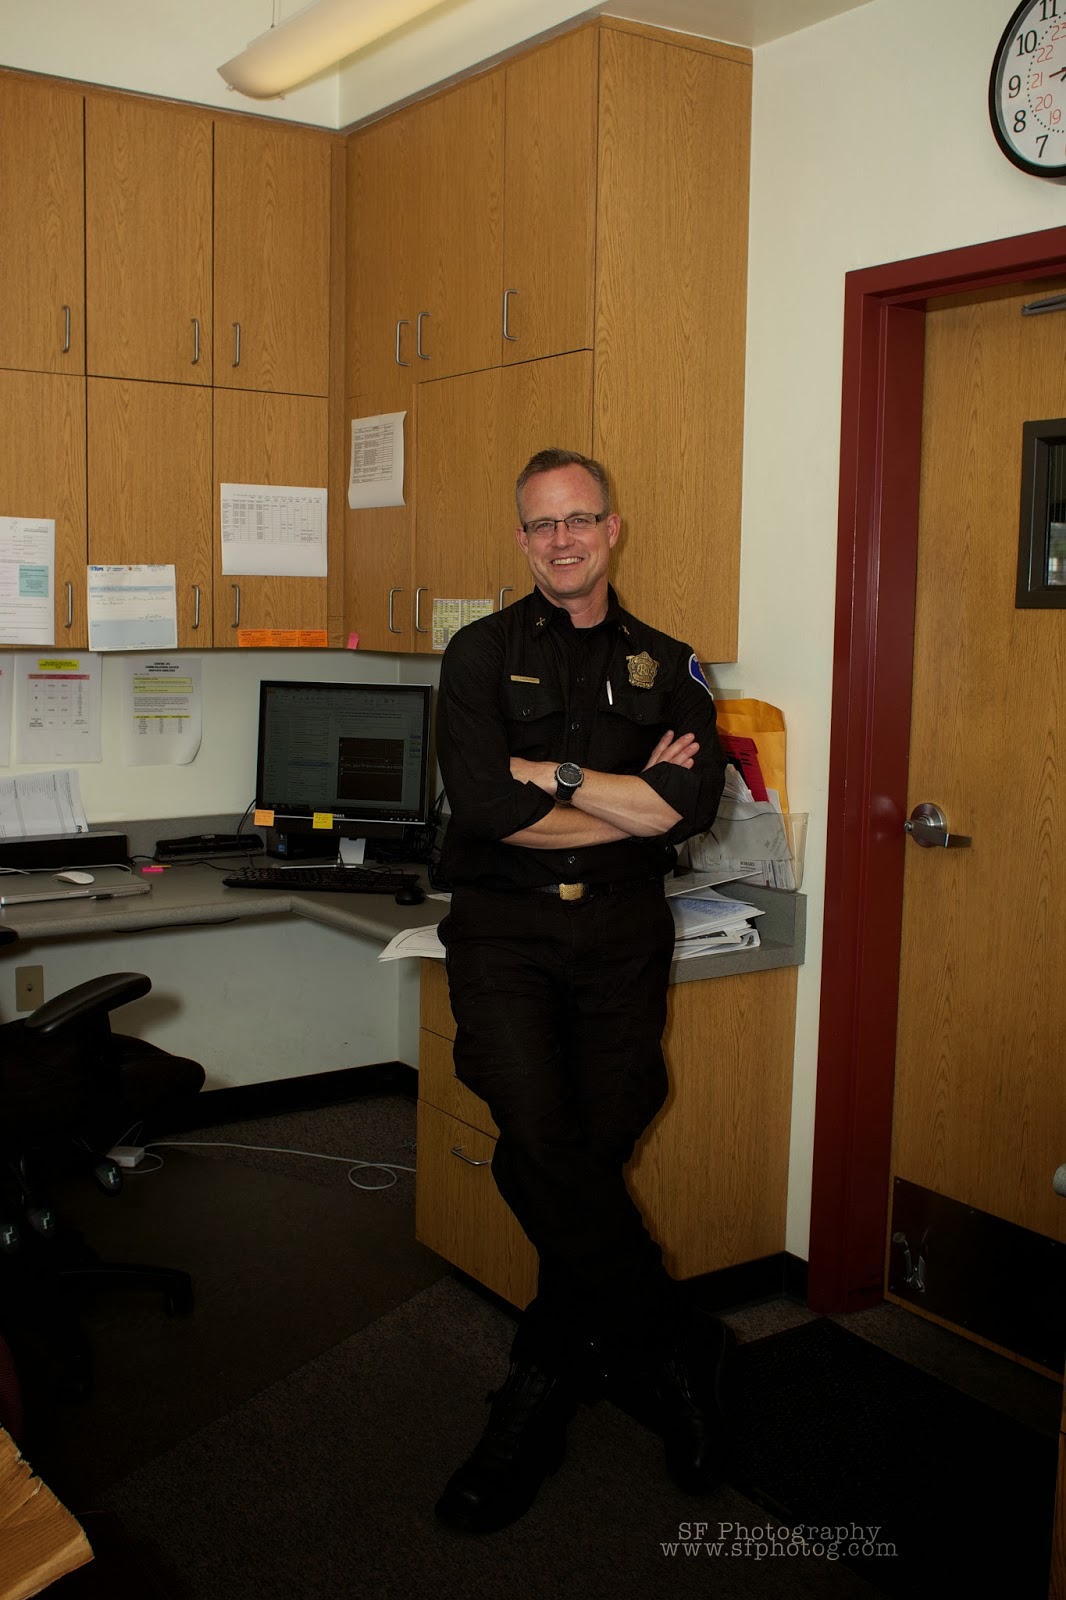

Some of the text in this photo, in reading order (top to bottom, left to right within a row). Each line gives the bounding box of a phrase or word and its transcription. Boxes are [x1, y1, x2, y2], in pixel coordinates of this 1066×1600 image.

[1039, 0, 1058, 22] 11
[1016, 30, 1038, 57] 10
[1036, 45, 1054, 63] 22
[1008, 75, 1021, 99] 9
[1031, 72, 1043, 89] 21
[1034, 94, 1053, 112] 20
[1013, 110, 1026, 133] 8
[1049, 109, 1062, 126] 19
[1035, 134, 1049, 158] 7
